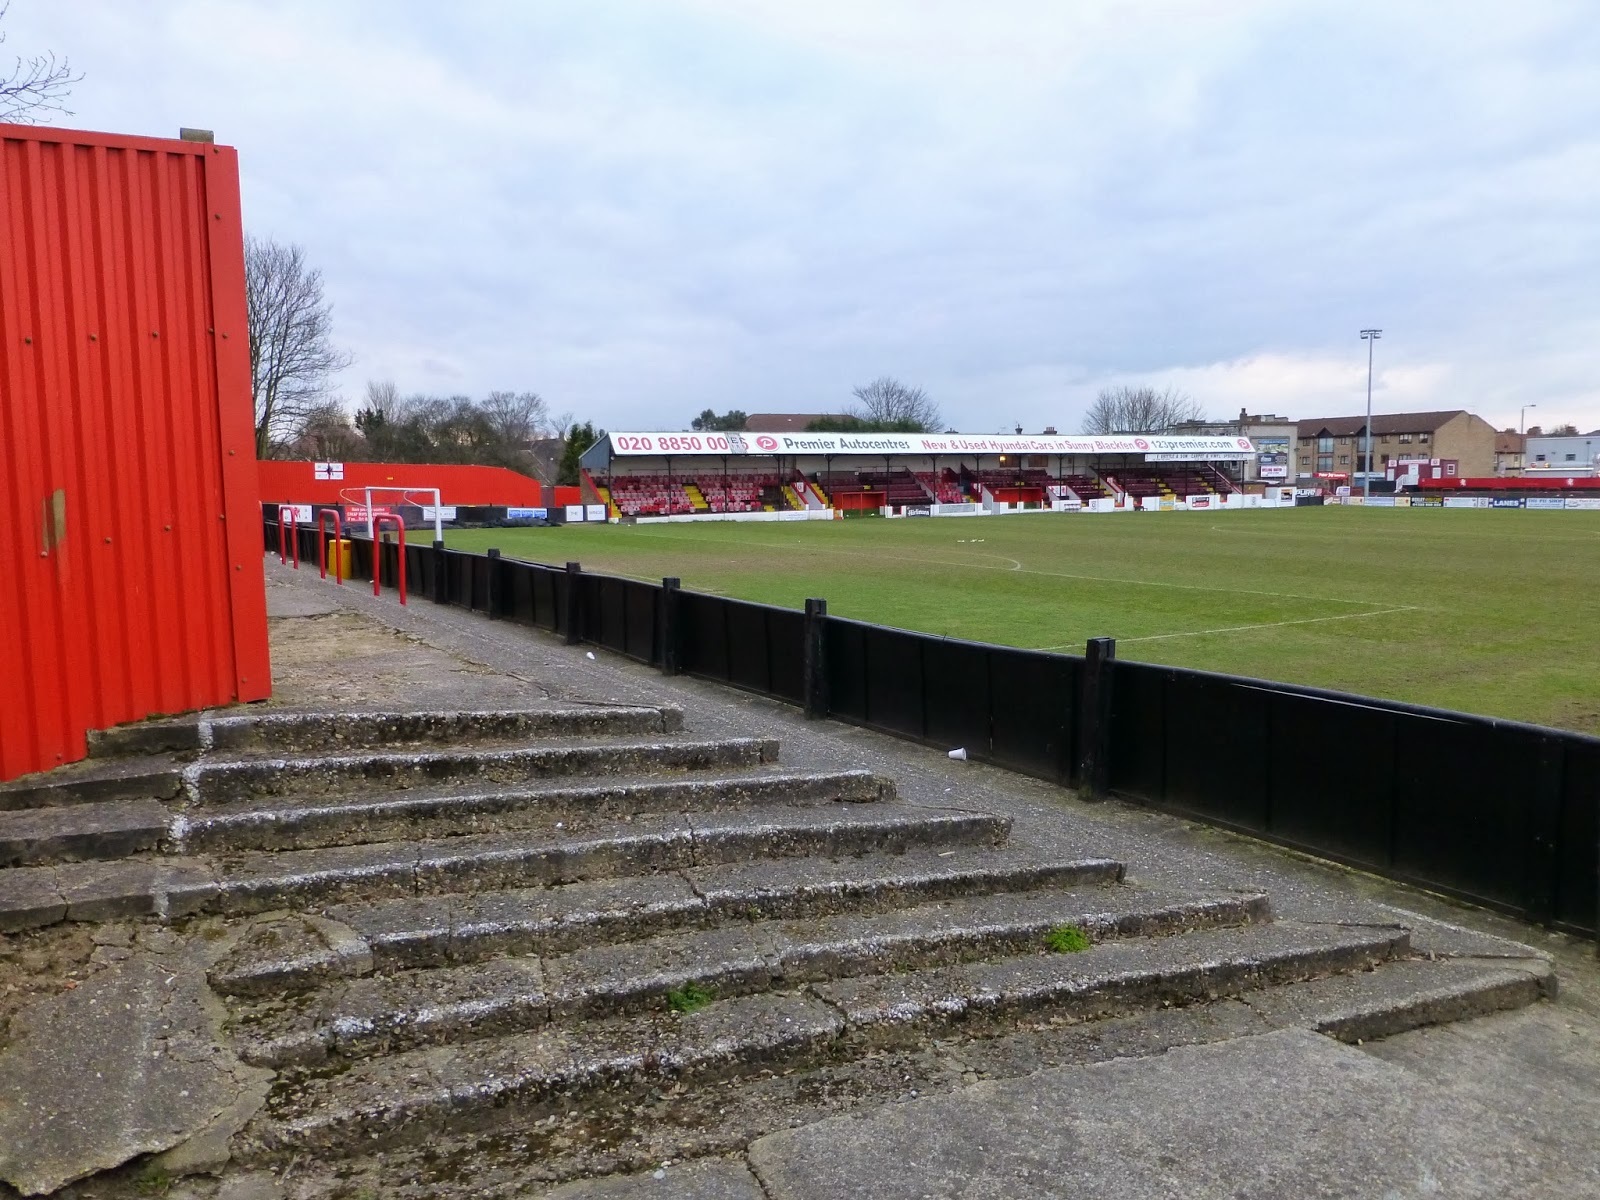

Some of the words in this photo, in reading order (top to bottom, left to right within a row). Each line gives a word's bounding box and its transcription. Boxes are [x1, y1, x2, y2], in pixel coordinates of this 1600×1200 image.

[618, 437, 652, 450] 020
[658, 437, 702, 450] 8850
[783, 438, 836, 449] Premier
[840, 438, 910, 449] Autocentres
[921, 440, 947, 450] New
[950, 440, 958, 450] &
[959, 440, 988, 450] Used
[989, 441, 1031, 452] Hyundai
[1031, 441, 1052, 450] Cars
[1055, 441, 1065, 450] in
[1065, 441, 1094, 451] Sunny
[1095, 441, 1135, 450] Blackfen
[1151, 440, 1233, 450] 123premier.com
